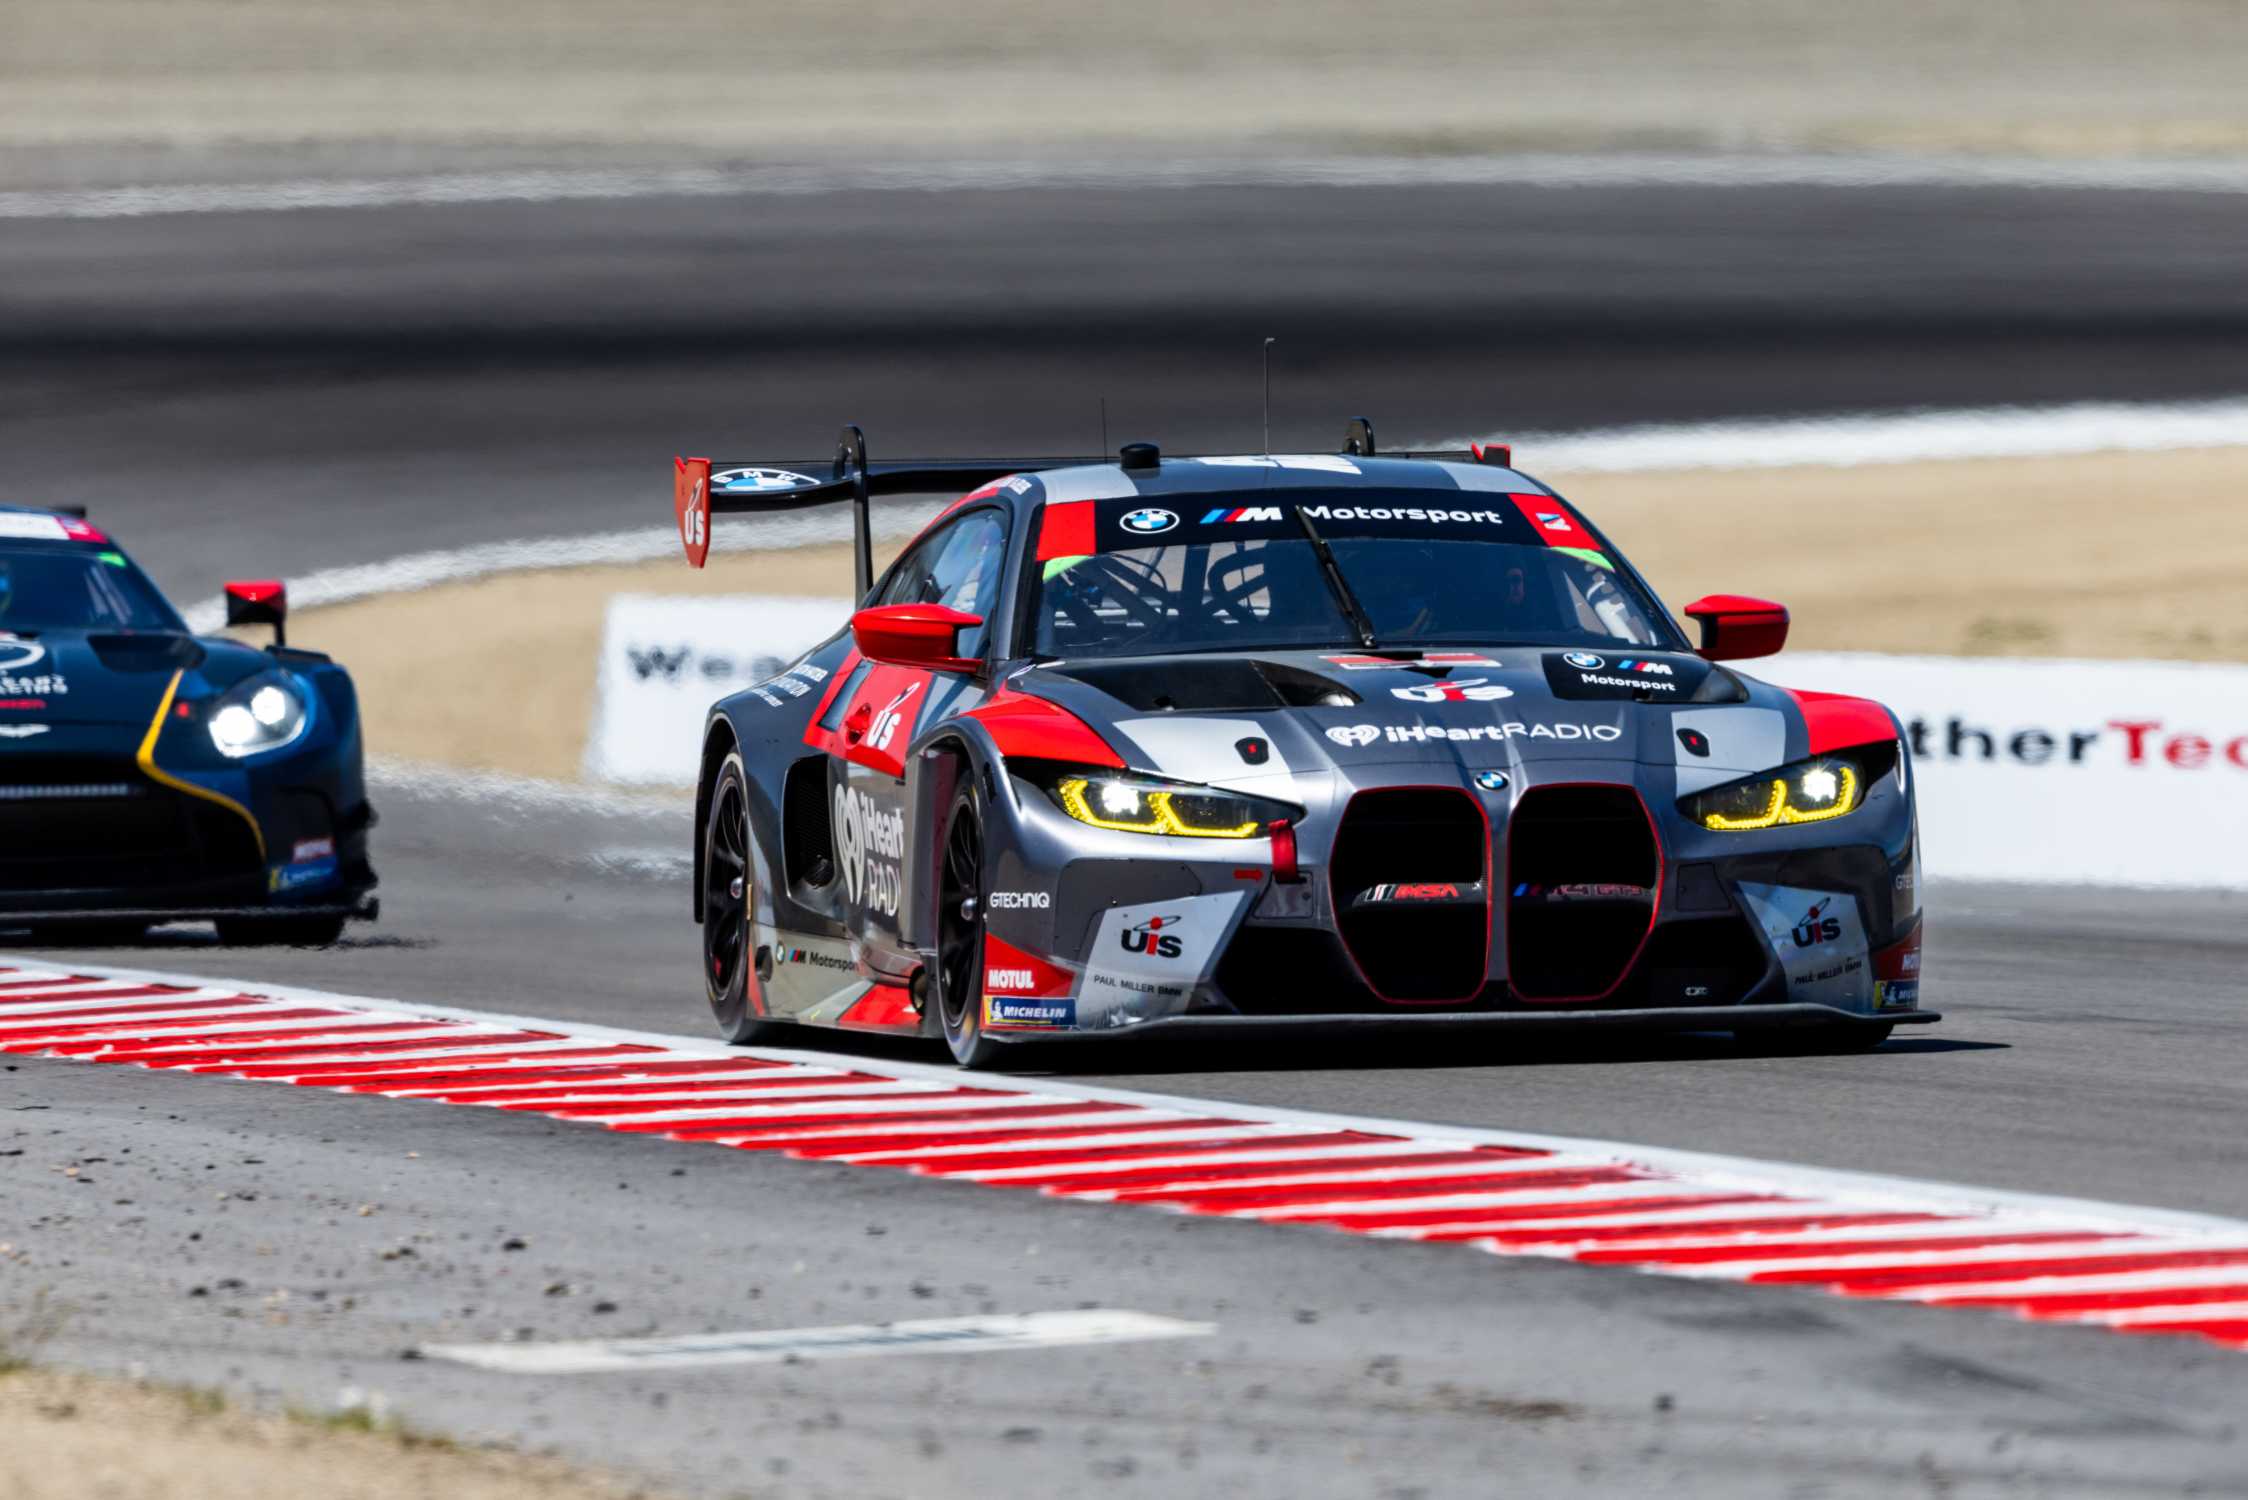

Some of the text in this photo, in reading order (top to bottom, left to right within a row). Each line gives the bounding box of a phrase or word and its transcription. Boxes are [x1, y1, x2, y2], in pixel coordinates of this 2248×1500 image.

[1301, 505, 1504, 524] Motorsport
[1581, 673, 1677, 692] Motorsport
[989, 891, 1050, 909] GTECHNIQ
[988, 969, 1035, 990] MOTUL
[1094, 974, 1118, 988] PAUL
[1121, 979, 1155, 994] MILLER
[1003, 1005, 1068, 1019] MICHELIN
